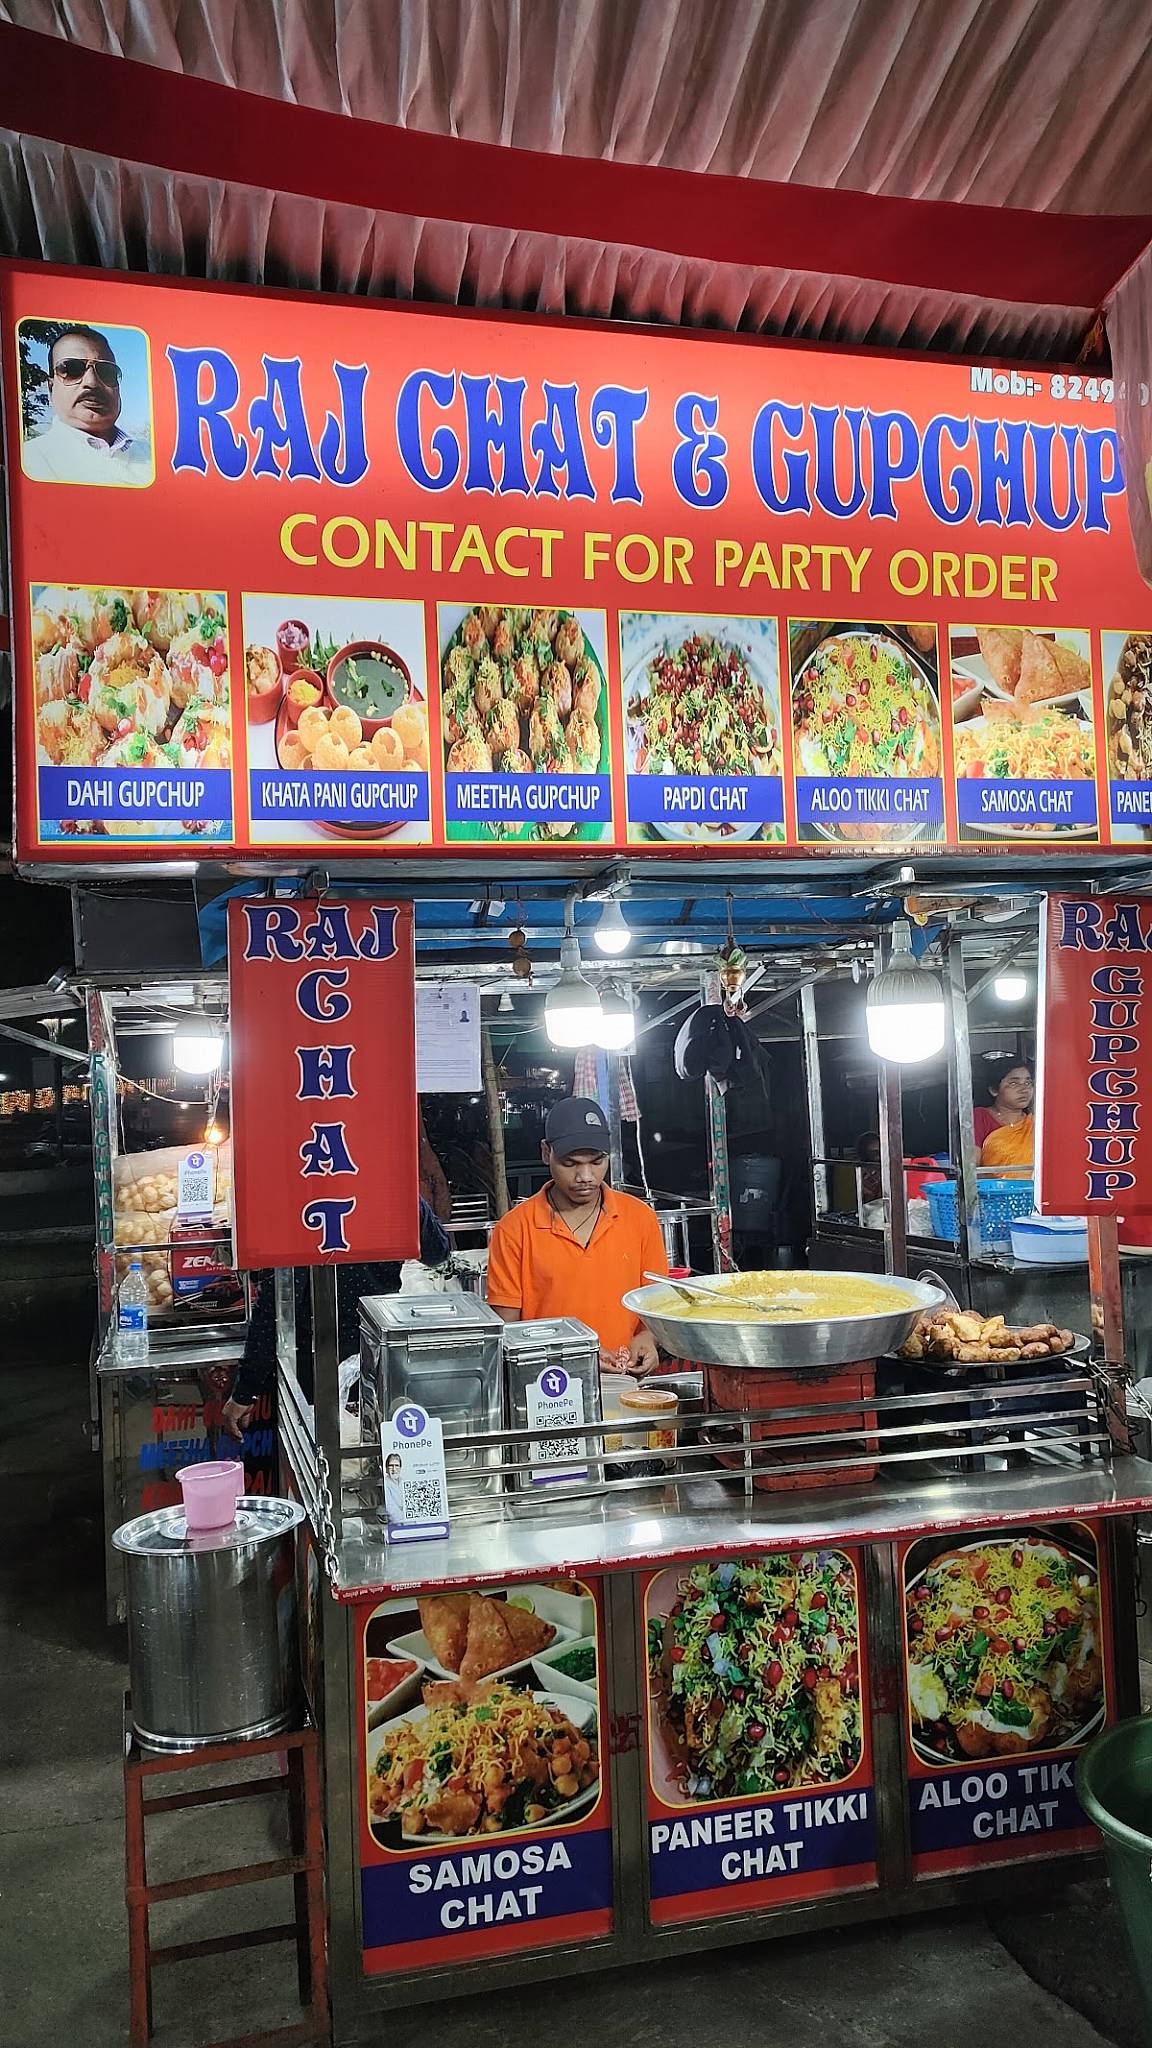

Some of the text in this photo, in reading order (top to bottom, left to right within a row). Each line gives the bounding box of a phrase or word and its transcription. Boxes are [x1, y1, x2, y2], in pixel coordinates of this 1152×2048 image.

[165, 343, 1127, 534] RAJ CHAT & GUPCHUP
[279, 513, 1059, 602] CONTACT FOR PARTY ORDER
[66, 779, 206, 809] DAHI GUPCHUP
[261, 781, 418, 809] KHATA PANI GUPCHUP
[456, 783, 601, 811] MEETHA GUPCHUP
[663, 786, 749, 811] PAPDI CHAT
[811, 787, 930, 812] ALOO TIKKI CHAT
[980, 789, 1074, 813] SAMOSA CHAT
[241, 903, 401, 963] RAJ
[1058, 900, 1152, 953] RA
[1084, 965, 1145, 1202] GUPCHUP
[294, 966, 359, 1254] CHAT
[537, 1398, 574, 1411] PhonePe
[392, 1438, 433, 1451] PhonePe
[917, 1761, 1075, 1811] ALOO TIK
[650, 1793, 869, 1854] PANEER TIKKI
[971, 1801, 1060, 1839] CHAT
[408, 1841, 573, 1895] SAMOSA
[720, 1841, 805, 1881] CHAT
[439, 1886, 544, 1930] CHAT
